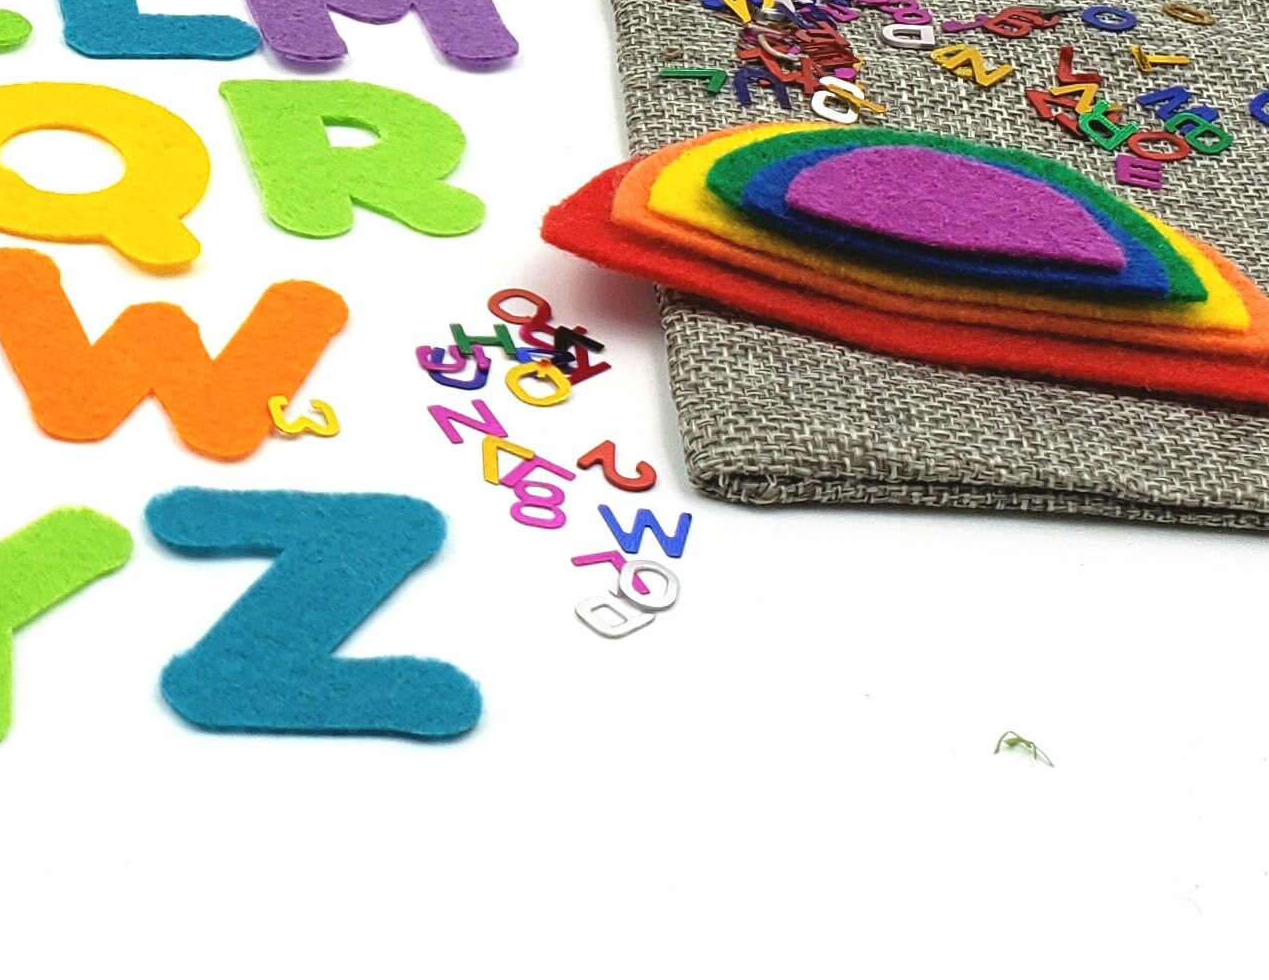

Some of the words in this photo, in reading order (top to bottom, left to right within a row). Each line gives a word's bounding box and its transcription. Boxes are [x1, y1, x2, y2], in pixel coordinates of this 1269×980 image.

[219, 80, 485, 237] R
[449, 323, 519, 356] H
[509, 479, 567, 531] 8
[596, 503, 694, 559] W
[145, 488, 482, 743] Z
